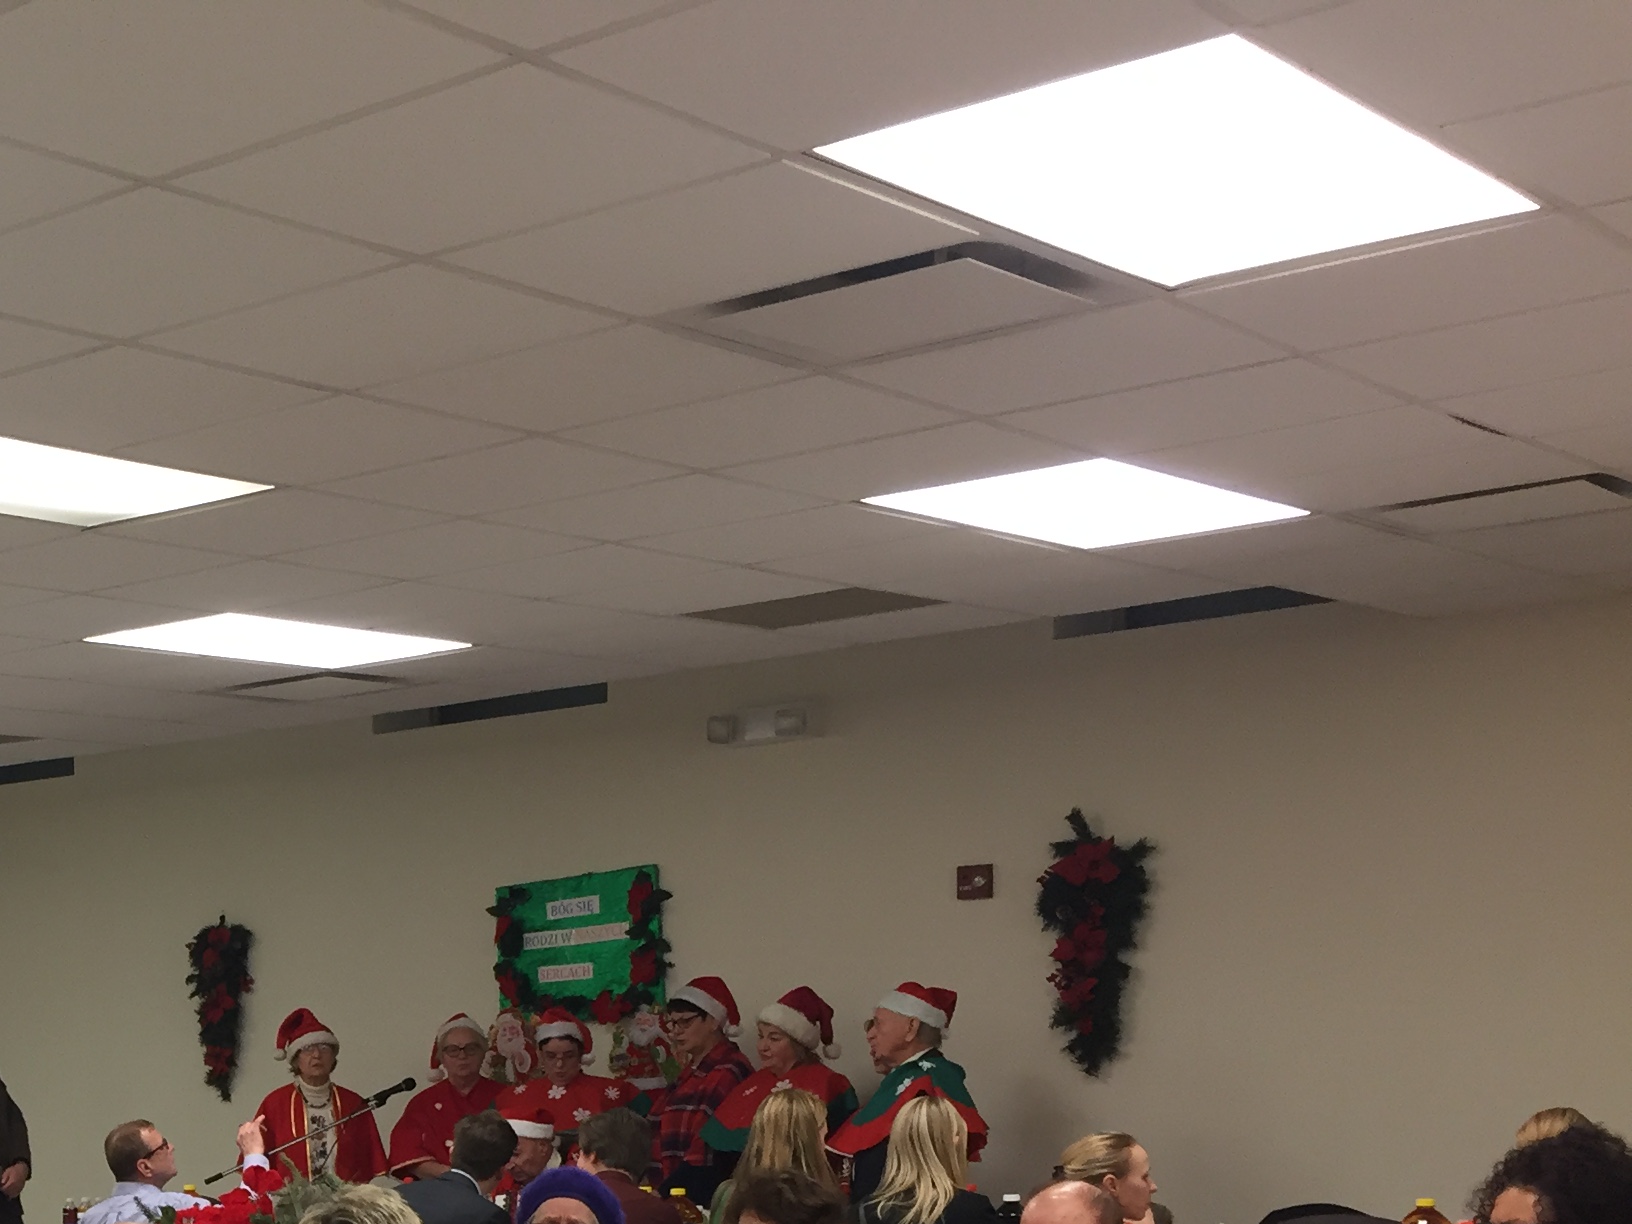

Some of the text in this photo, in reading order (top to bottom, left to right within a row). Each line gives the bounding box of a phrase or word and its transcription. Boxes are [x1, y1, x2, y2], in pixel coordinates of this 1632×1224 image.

[550, 902, 573, 917] BÓG
[524, 933, 558, 948] RODZI
[539, 965, 591, 981] SERCACH
